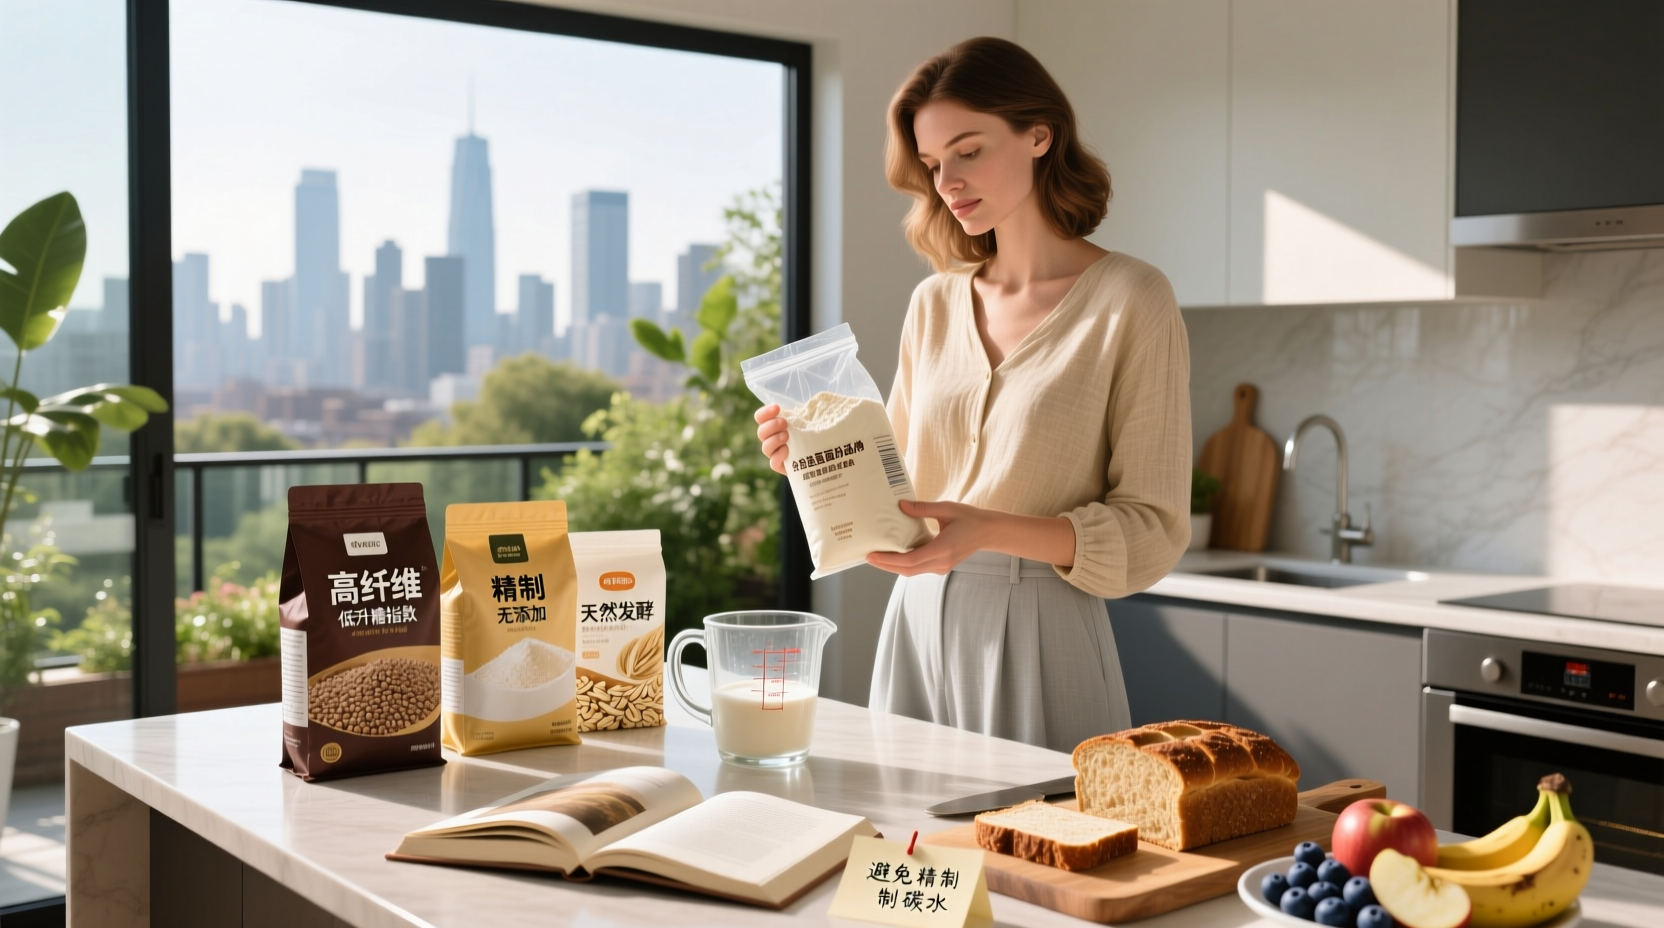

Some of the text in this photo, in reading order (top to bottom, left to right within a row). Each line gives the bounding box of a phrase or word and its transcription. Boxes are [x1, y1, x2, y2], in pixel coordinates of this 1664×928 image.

[327, 567, 422, 606] 高纤维
[491, 573, 546, 603] 精制
[497, 604, 547, 624] 无添加
[581, 599, 654, 623] 天然发酵
[866, 861, 960, 890] 避免精制
[878, 887, 948, 913] 制碳水
